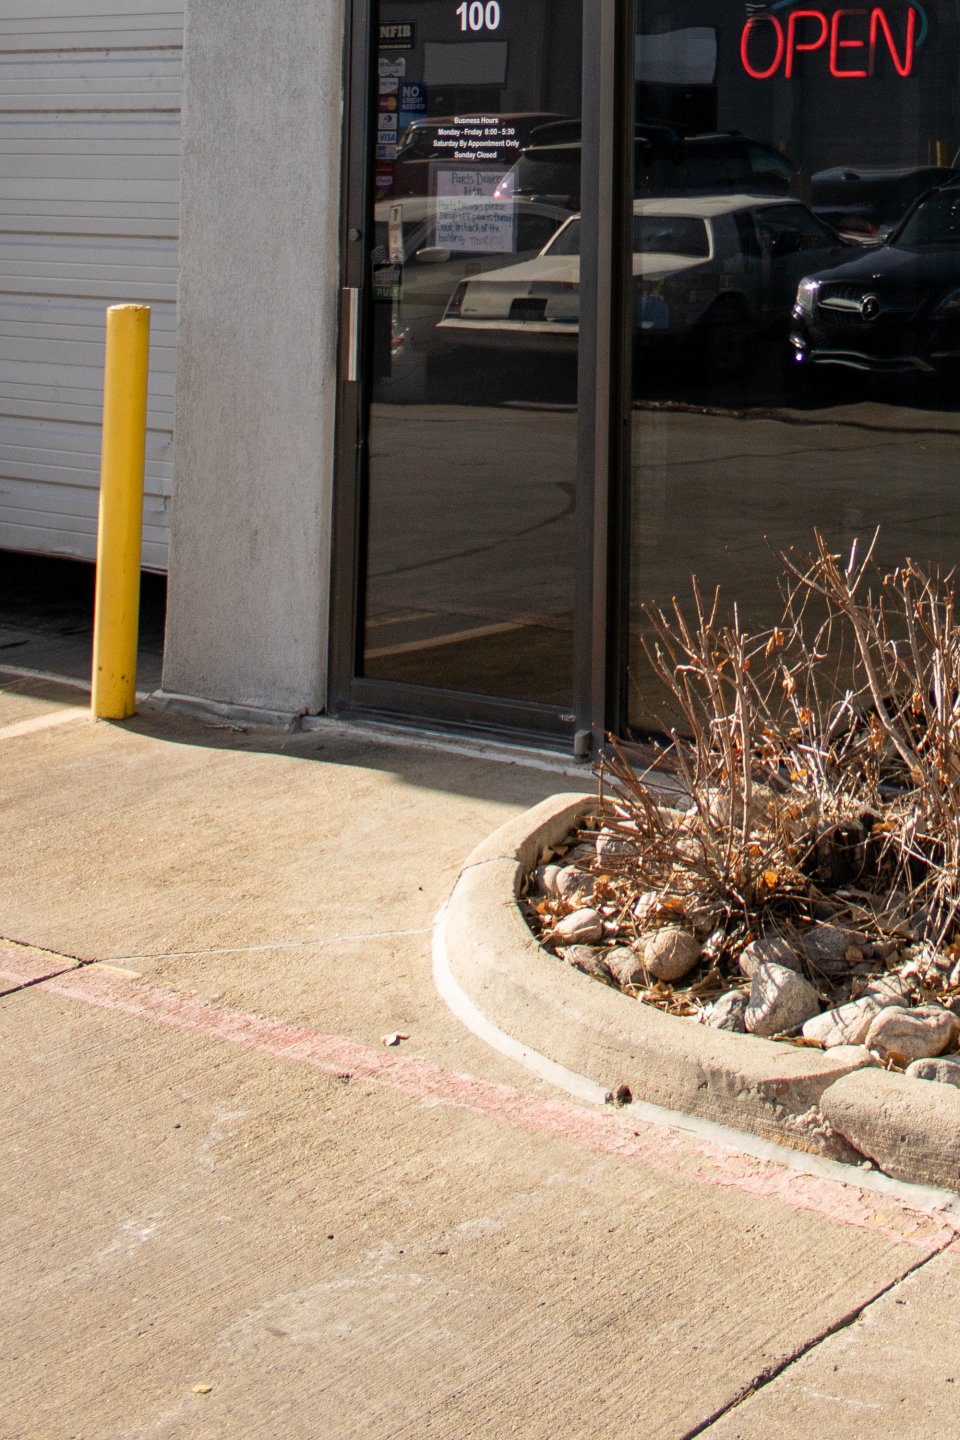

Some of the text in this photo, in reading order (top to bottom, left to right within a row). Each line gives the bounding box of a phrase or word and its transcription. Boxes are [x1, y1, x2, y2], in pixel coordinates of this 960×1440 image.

[456, 0, 500, 31] 100
[379, 24, 412, 38] NFIB
[741, 6, 916, 79] OPEN
[402, 85, 420, 98] NO
[381, 132, 396, 141] VISA
[437, 128, 460, 137] Monday
[464, 128, 482, 137] Friday
[433, 140, 520, 148] Saturday By Appointment Only
[454, 151, 476, 159] Sunday
